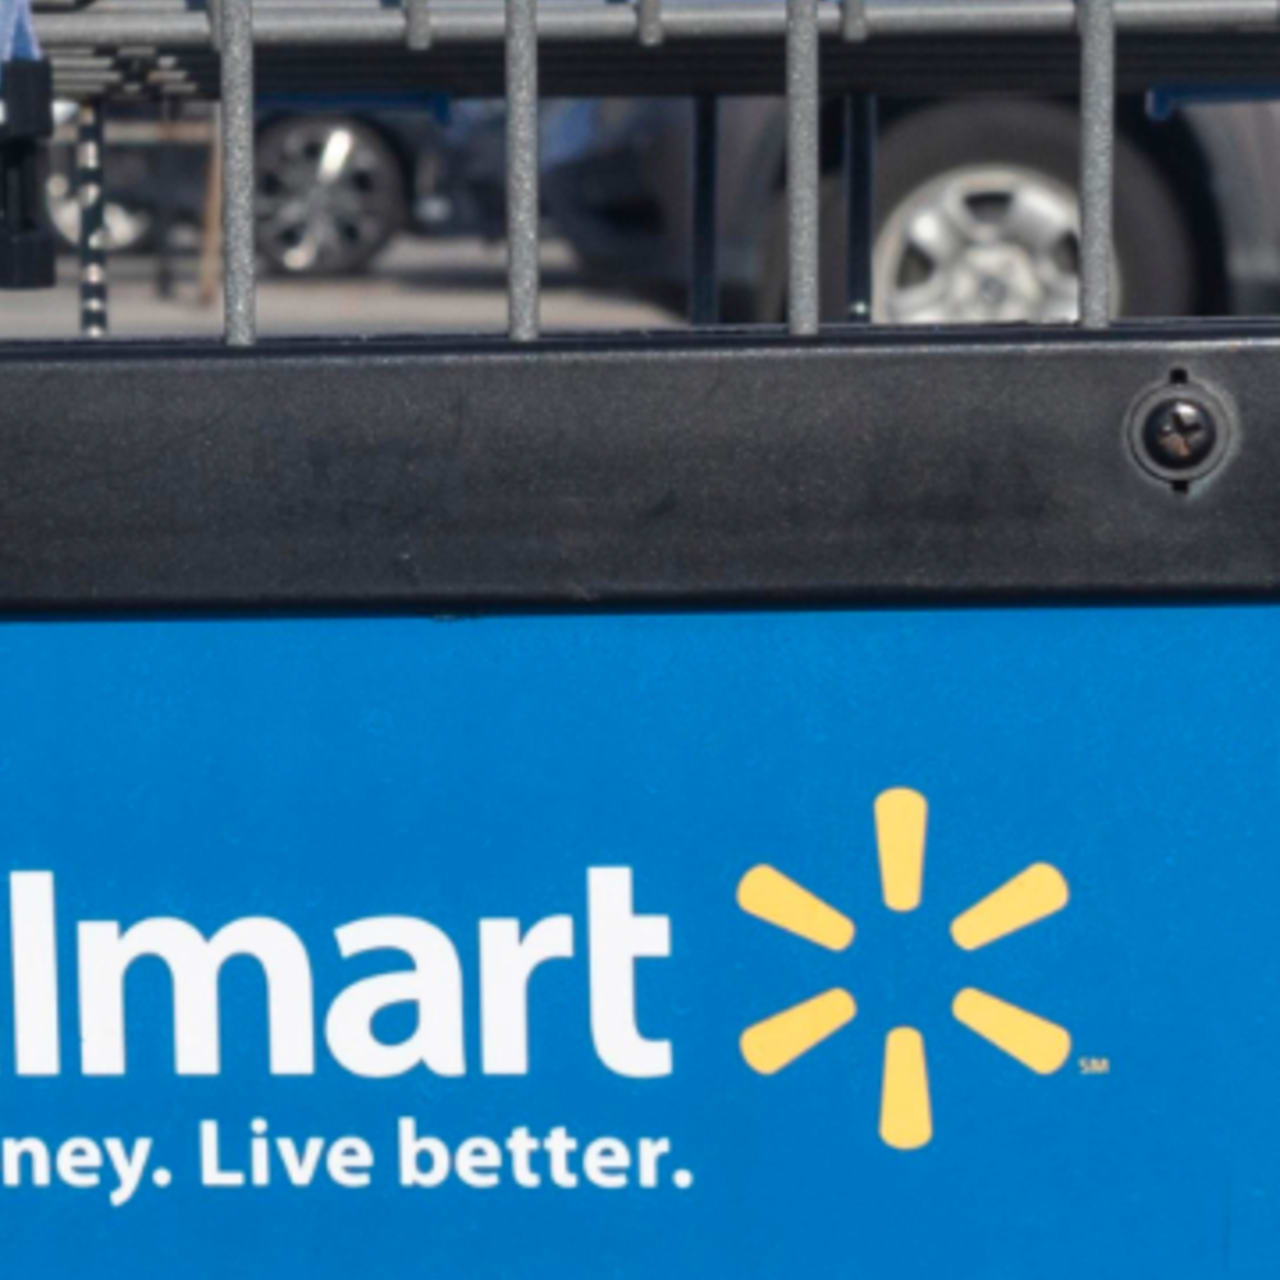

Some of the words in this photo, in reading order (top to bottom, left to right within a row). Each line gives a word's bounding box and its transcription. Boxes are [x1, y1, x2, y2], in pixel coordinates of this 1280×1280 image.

[1079, 1057, 1110, 1074] SM
[200, 1118, 374, 1188] Live
[398, 1116, 693, 1189] better.
